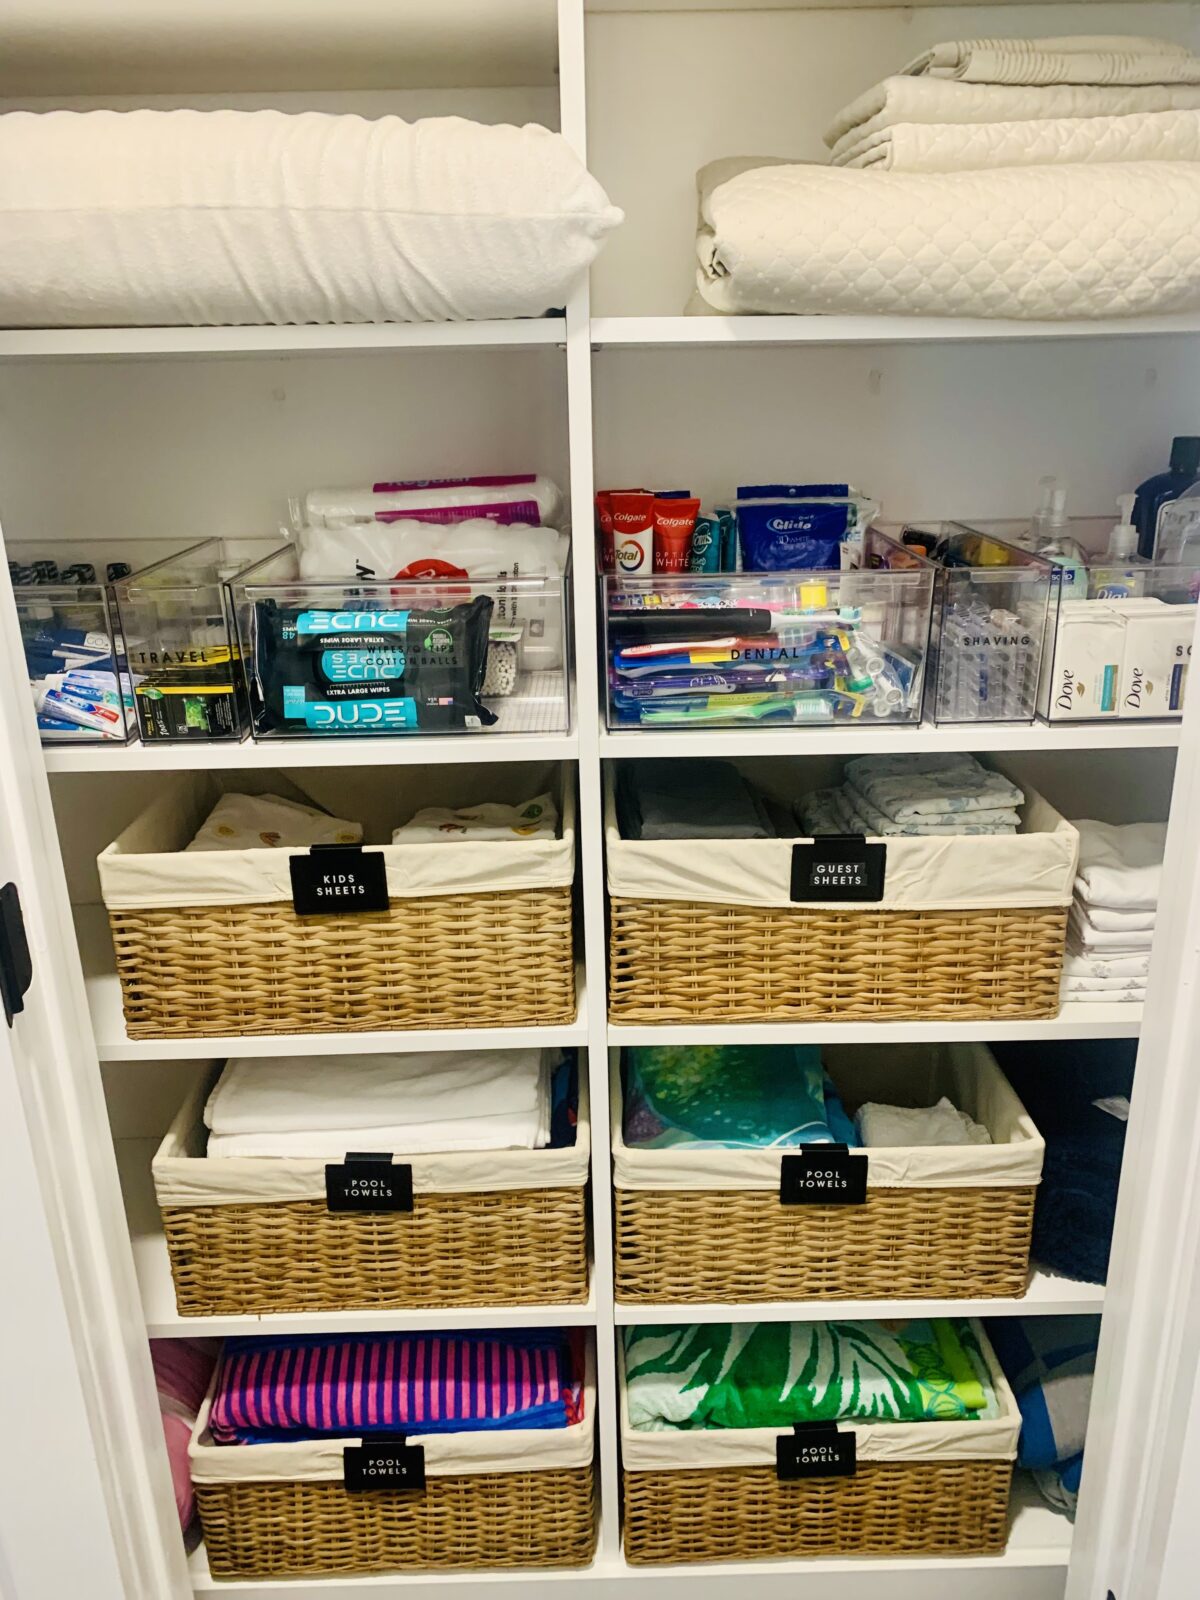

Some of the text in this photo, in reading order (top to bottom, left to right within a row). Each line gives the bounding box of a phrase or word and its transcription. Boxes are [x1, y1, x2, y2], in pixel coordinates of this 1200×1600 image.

[613, 512, 647, 522] Colgate
[656, 517, 694, 527] Colgate
[615, 549, 639, 561] Total
[656, 558, 689, 567] WHITE
[282, 631, 296, 639] 48
[963, 635, 1031, 646] SHAVING
[139, 651, 208, 664] TRAVEL
[731, 647, 799, 660] DENTAL
[366, 656, 457, 666] COTTON BALLS
[332, 664, 395, 679] DUDE
[1055, 669, 1074, 711] Dove
[1124, 667, 1143, 709] Dove
[314, 701, 406, 724] DUDE
[816, 864, 859, 873] GUEST
[323, 874, 355, 884] KIDS
[813, 876, 862, 885] SHEETS
[316, 885, 365, 896] SHEETS
[806, 1170, 840, 1178] POOL
[351, 1179, 386, 1188] POOL
[799, 1180, 847, 1188] TOWELS
[343, 1189, 392, 1197] TOWELS
[802, 1446, 834, 1455] POOL
[368, 1459, 401, 1467] POOL
[795, 1454, 840, 1463] TOWELS
[362, 1467, 407, 1475] TOWELS
